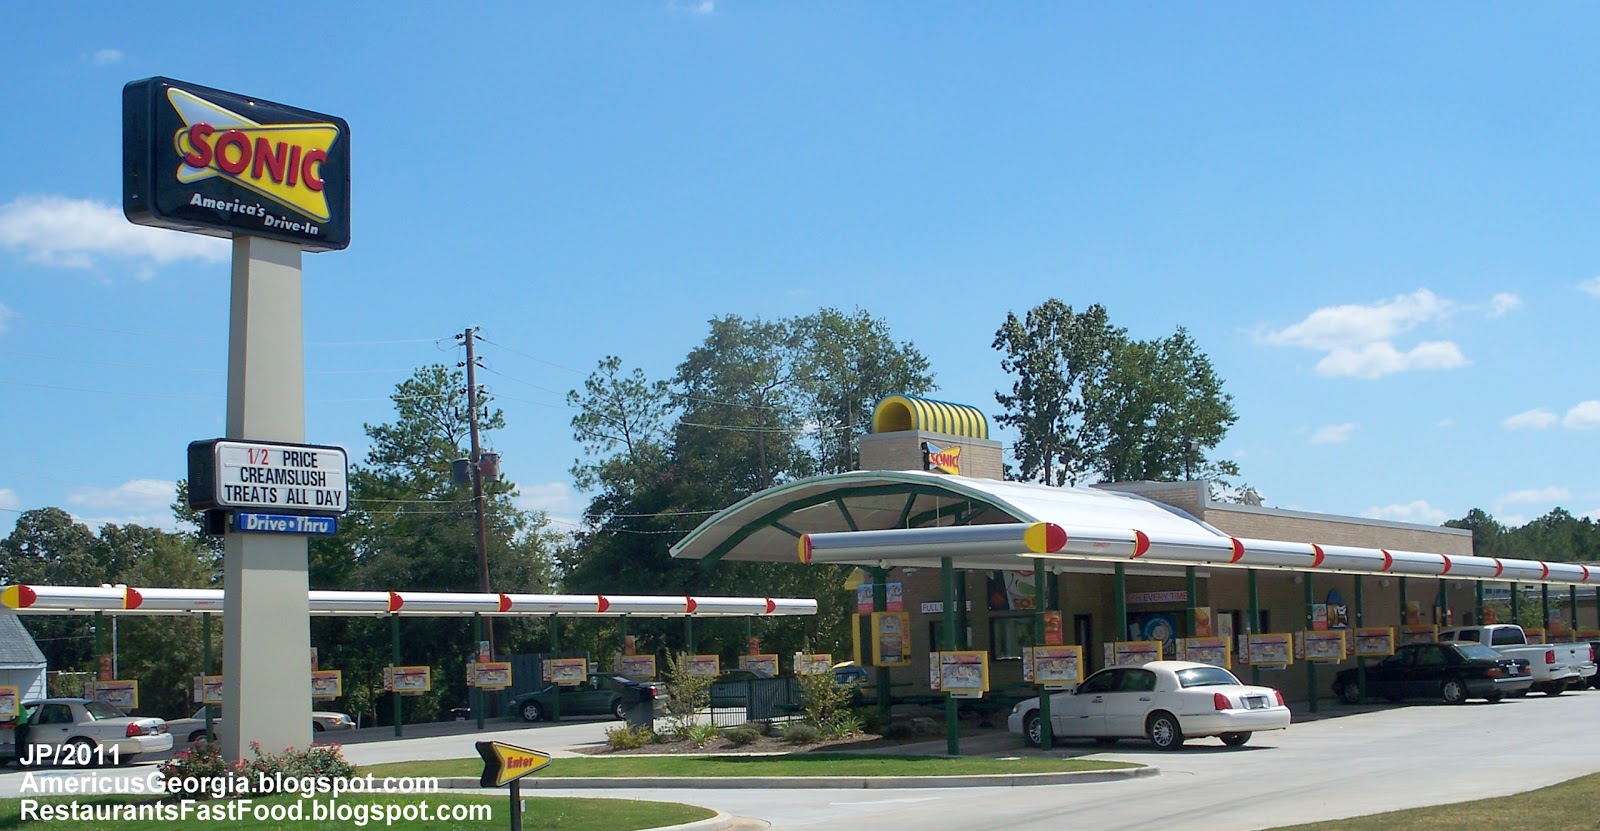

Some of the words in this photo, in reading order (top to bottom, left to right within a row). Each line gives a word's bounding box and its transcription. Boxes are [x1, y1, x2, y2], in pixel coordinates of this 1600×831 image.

[183, 122, 326, 191] SONIC
[189, 192, 265, 218] America's
[247, 448, 269, 466] 1/2
[283, 450, 318, 469] PRICE
[929, 452, 959, 468] SONIC
[240, 466, 326, 487] CREAMSLUSH
[225, 484, 277, 504] TREATS
[286, 488, 309, 505] ALL
[316, 489, 342, 506] DAY
[507, 756, 534, 769] Enter
